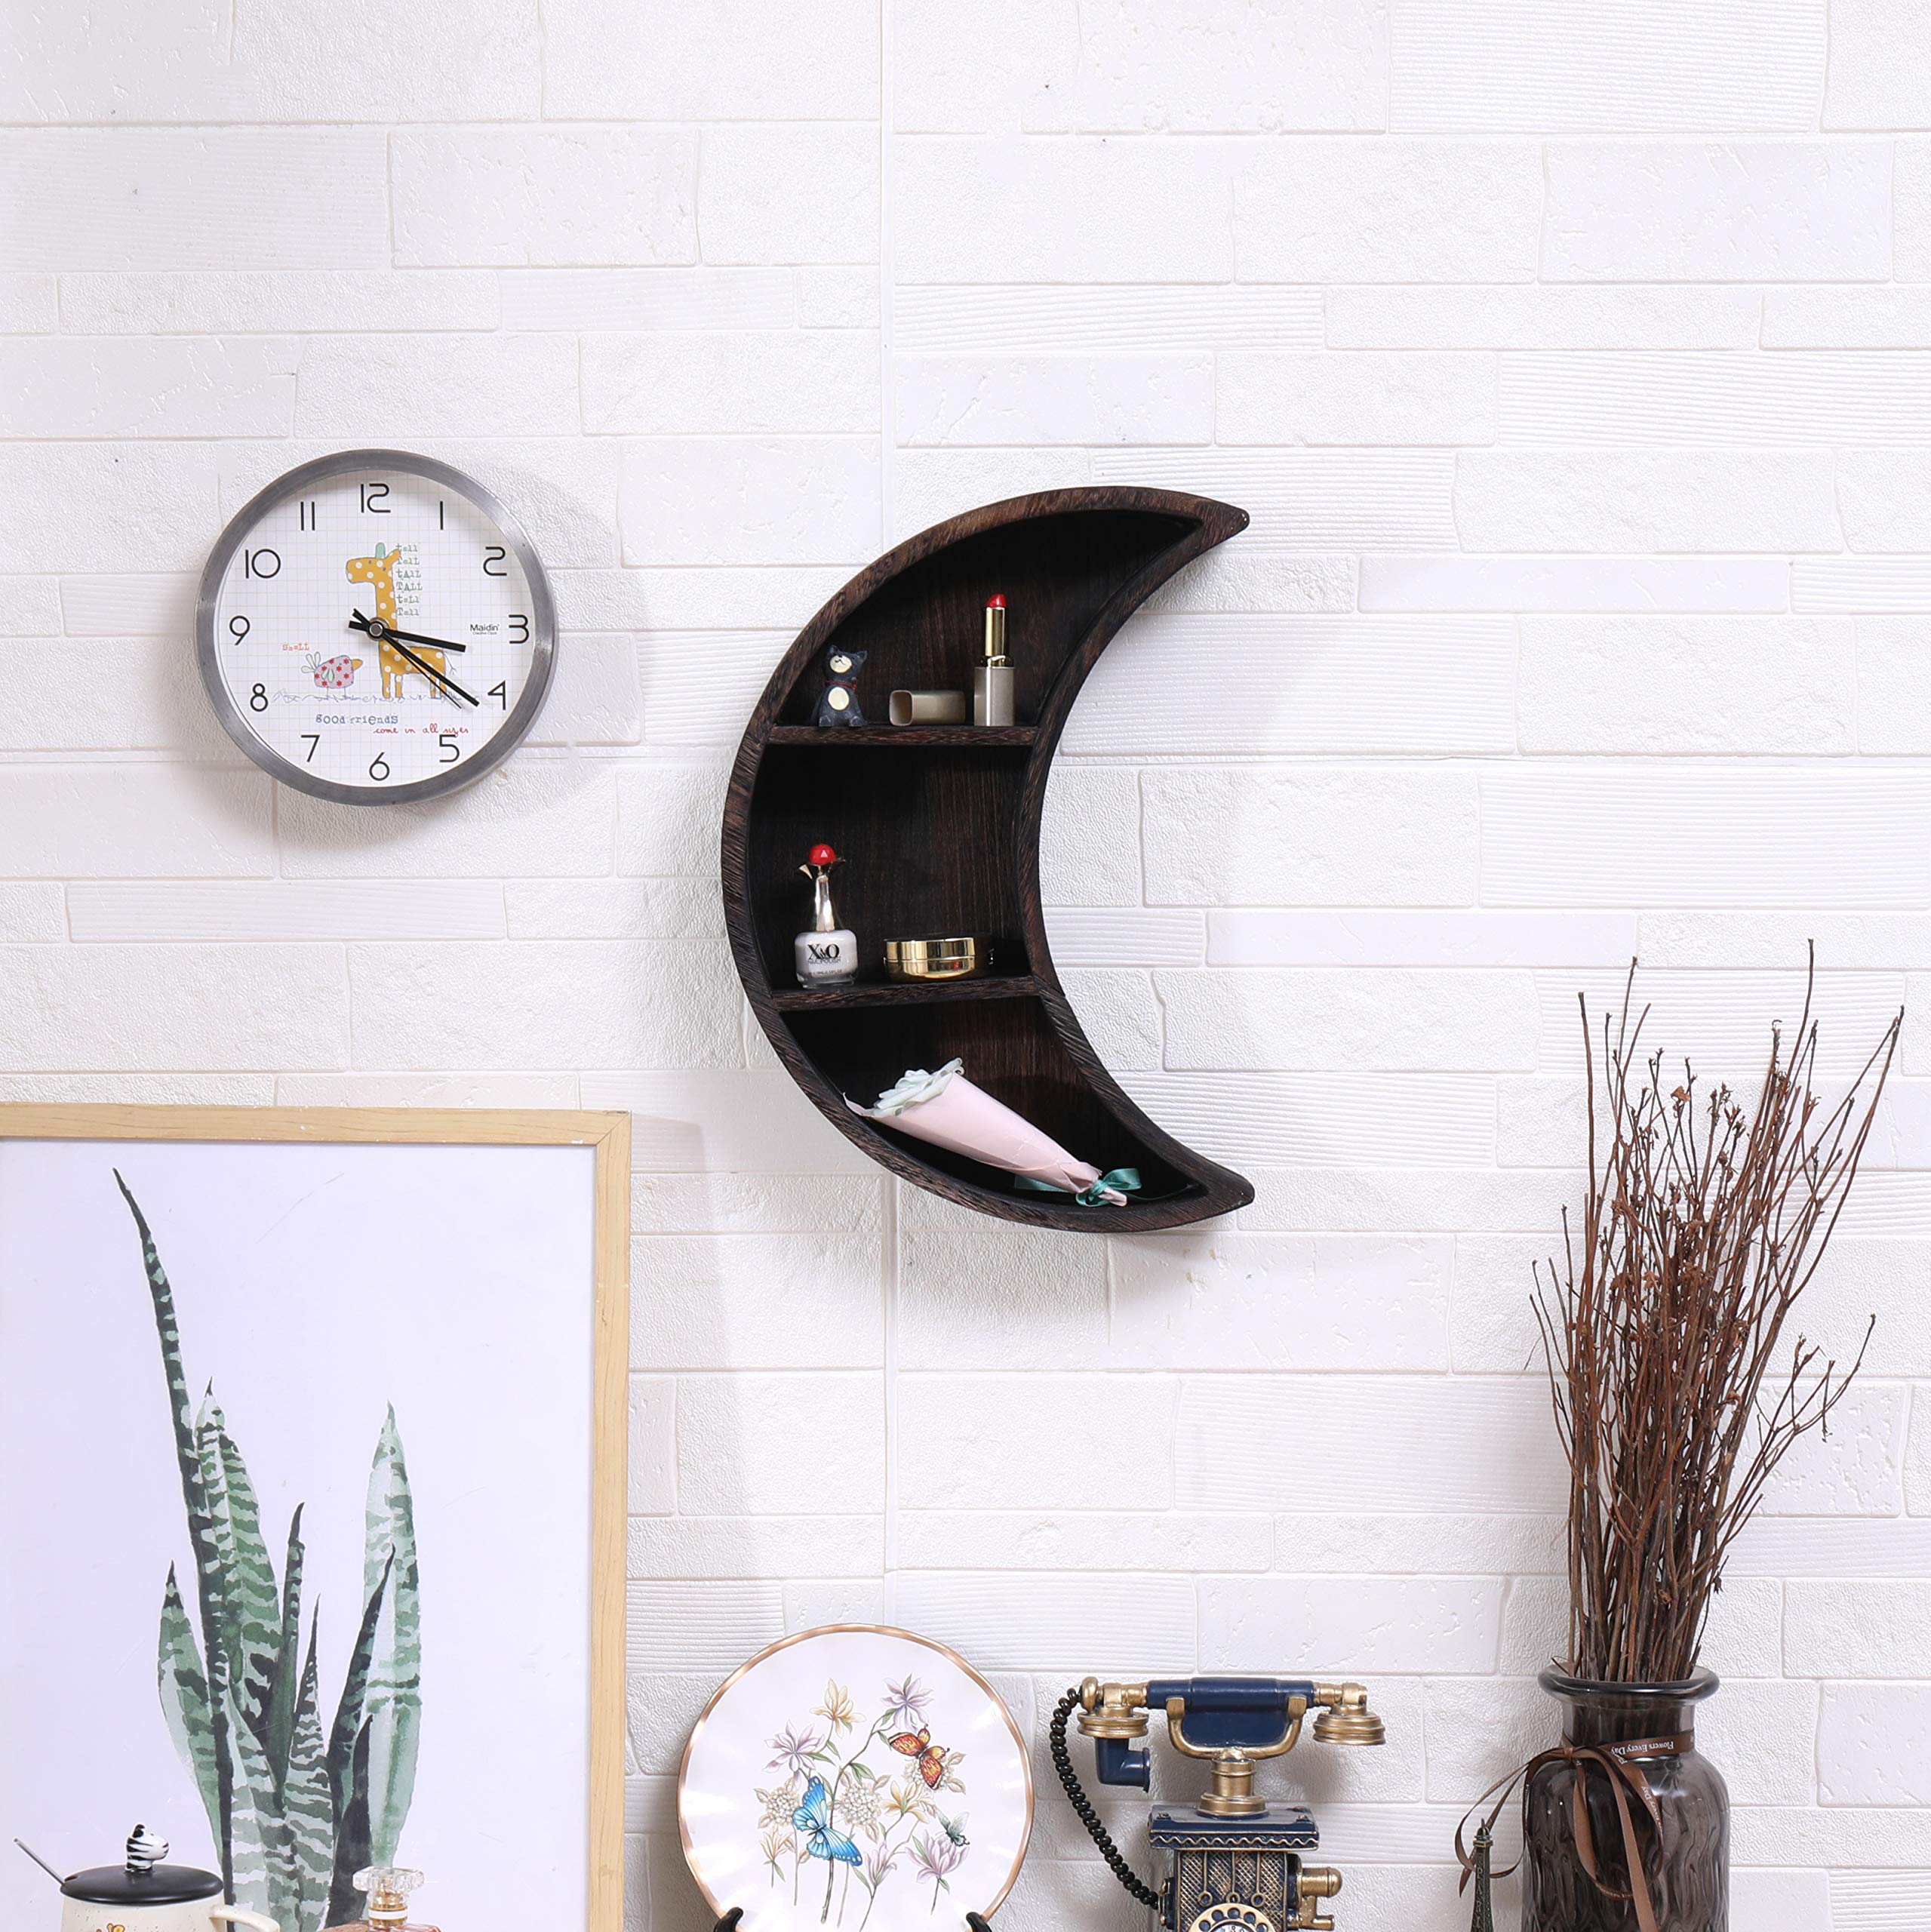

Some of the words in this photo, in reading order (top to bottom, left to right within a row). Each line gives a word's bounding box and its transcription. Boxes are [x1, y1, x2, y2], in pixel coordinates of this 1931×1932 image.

[361, 484, 391, 512] 12
[300, 501, 315, 531] 11
[439, 500, 444, 531] 1
[245, 549, 281, 578] 10
[484, 546, 507, 576] 2
[229, 616, 251, 645] 9
[508, 614, 530, 645] 3
[250, 683, 269, 712] 8
[487, 680, 506, 710] 4
[404, 726, 416, 734] in
[423, 722, 438, 734] all
[300, 735, 321, 763] 7
[439, 734, 460, 763] 5
[369, 752, 390, 781] 6
[1627, 1743, 1648, 1752] Every
[1648, 1741, 1674, 1750] Flowers
